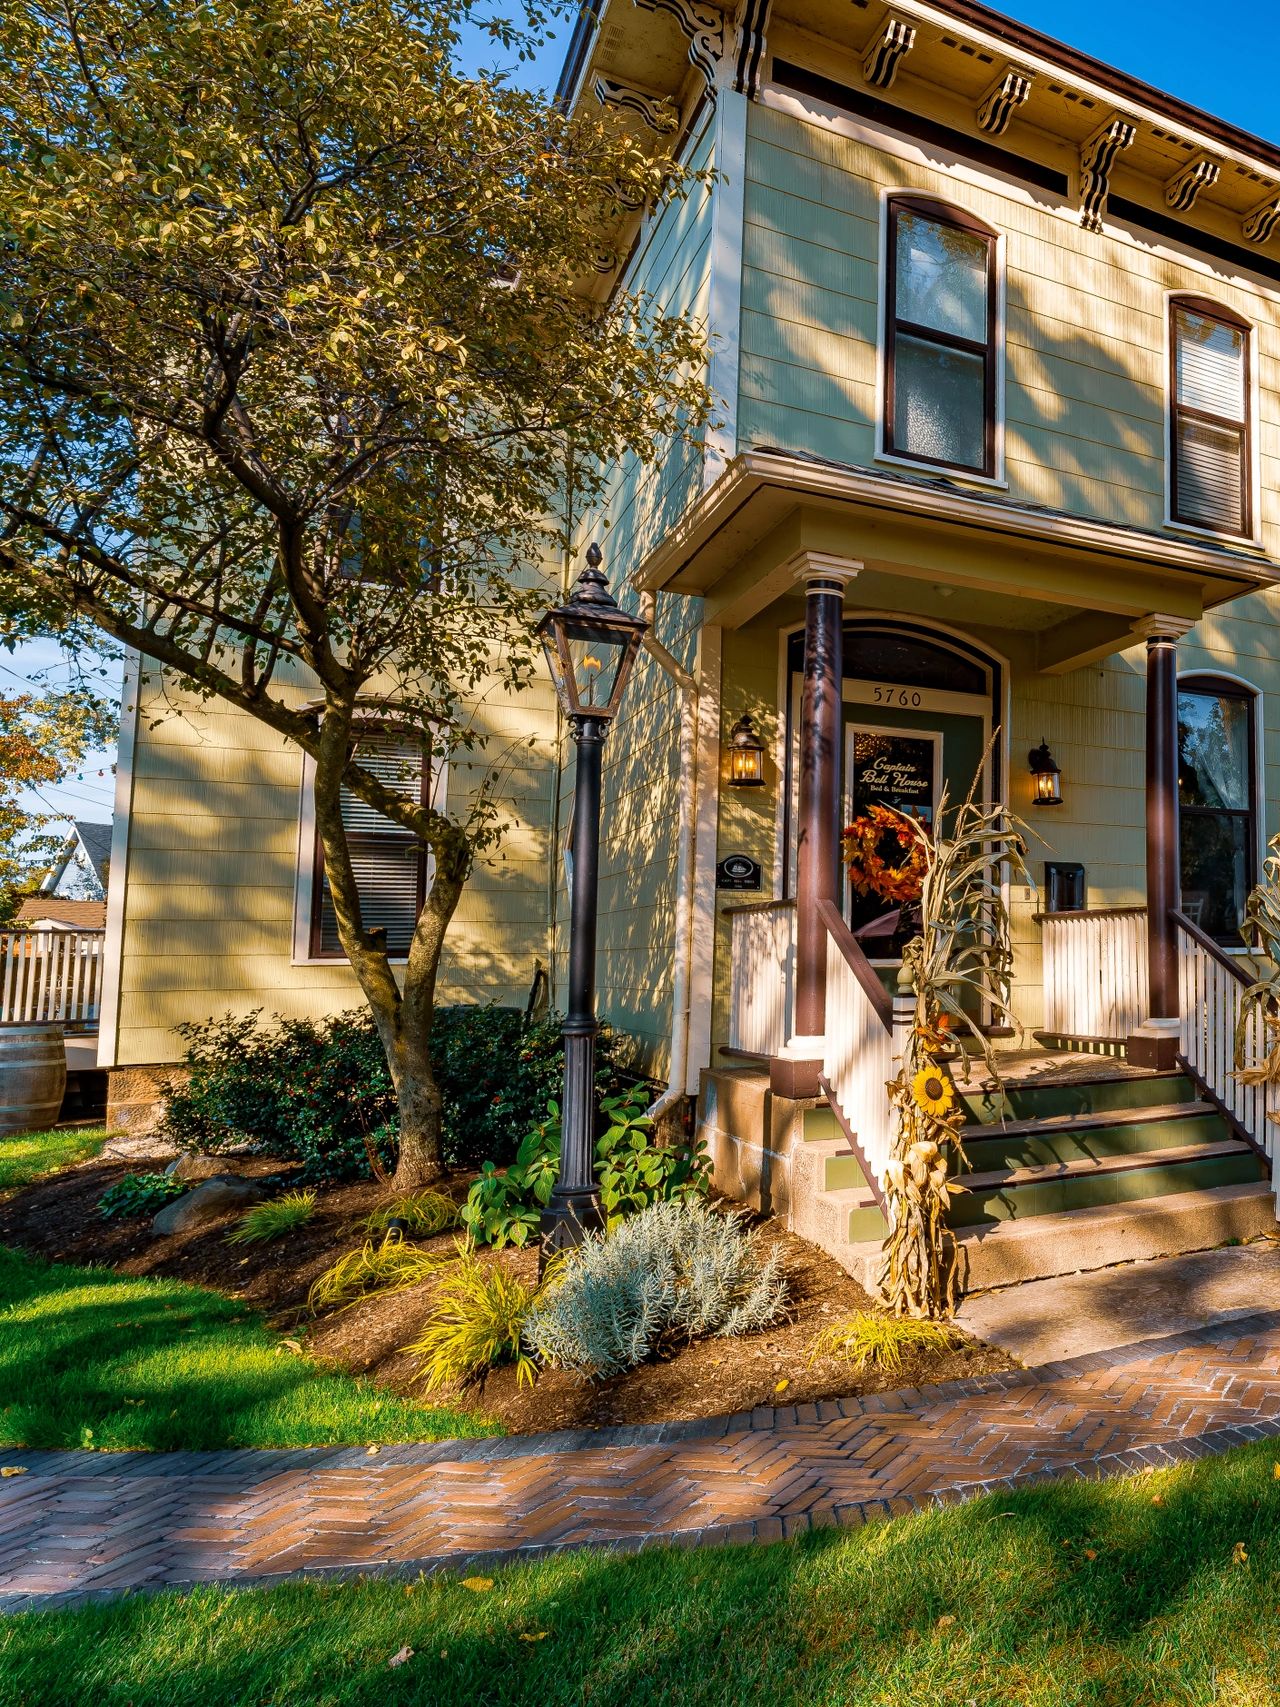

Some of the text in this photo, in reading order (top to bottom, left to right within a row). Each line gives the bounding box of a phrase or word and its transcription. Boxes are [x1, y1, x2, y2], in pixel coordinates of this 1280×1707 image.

[873, 687, 921, 706] 5760
[873, 757, 917, 773] Captain
[860, 769, 929, 787] Bell House
